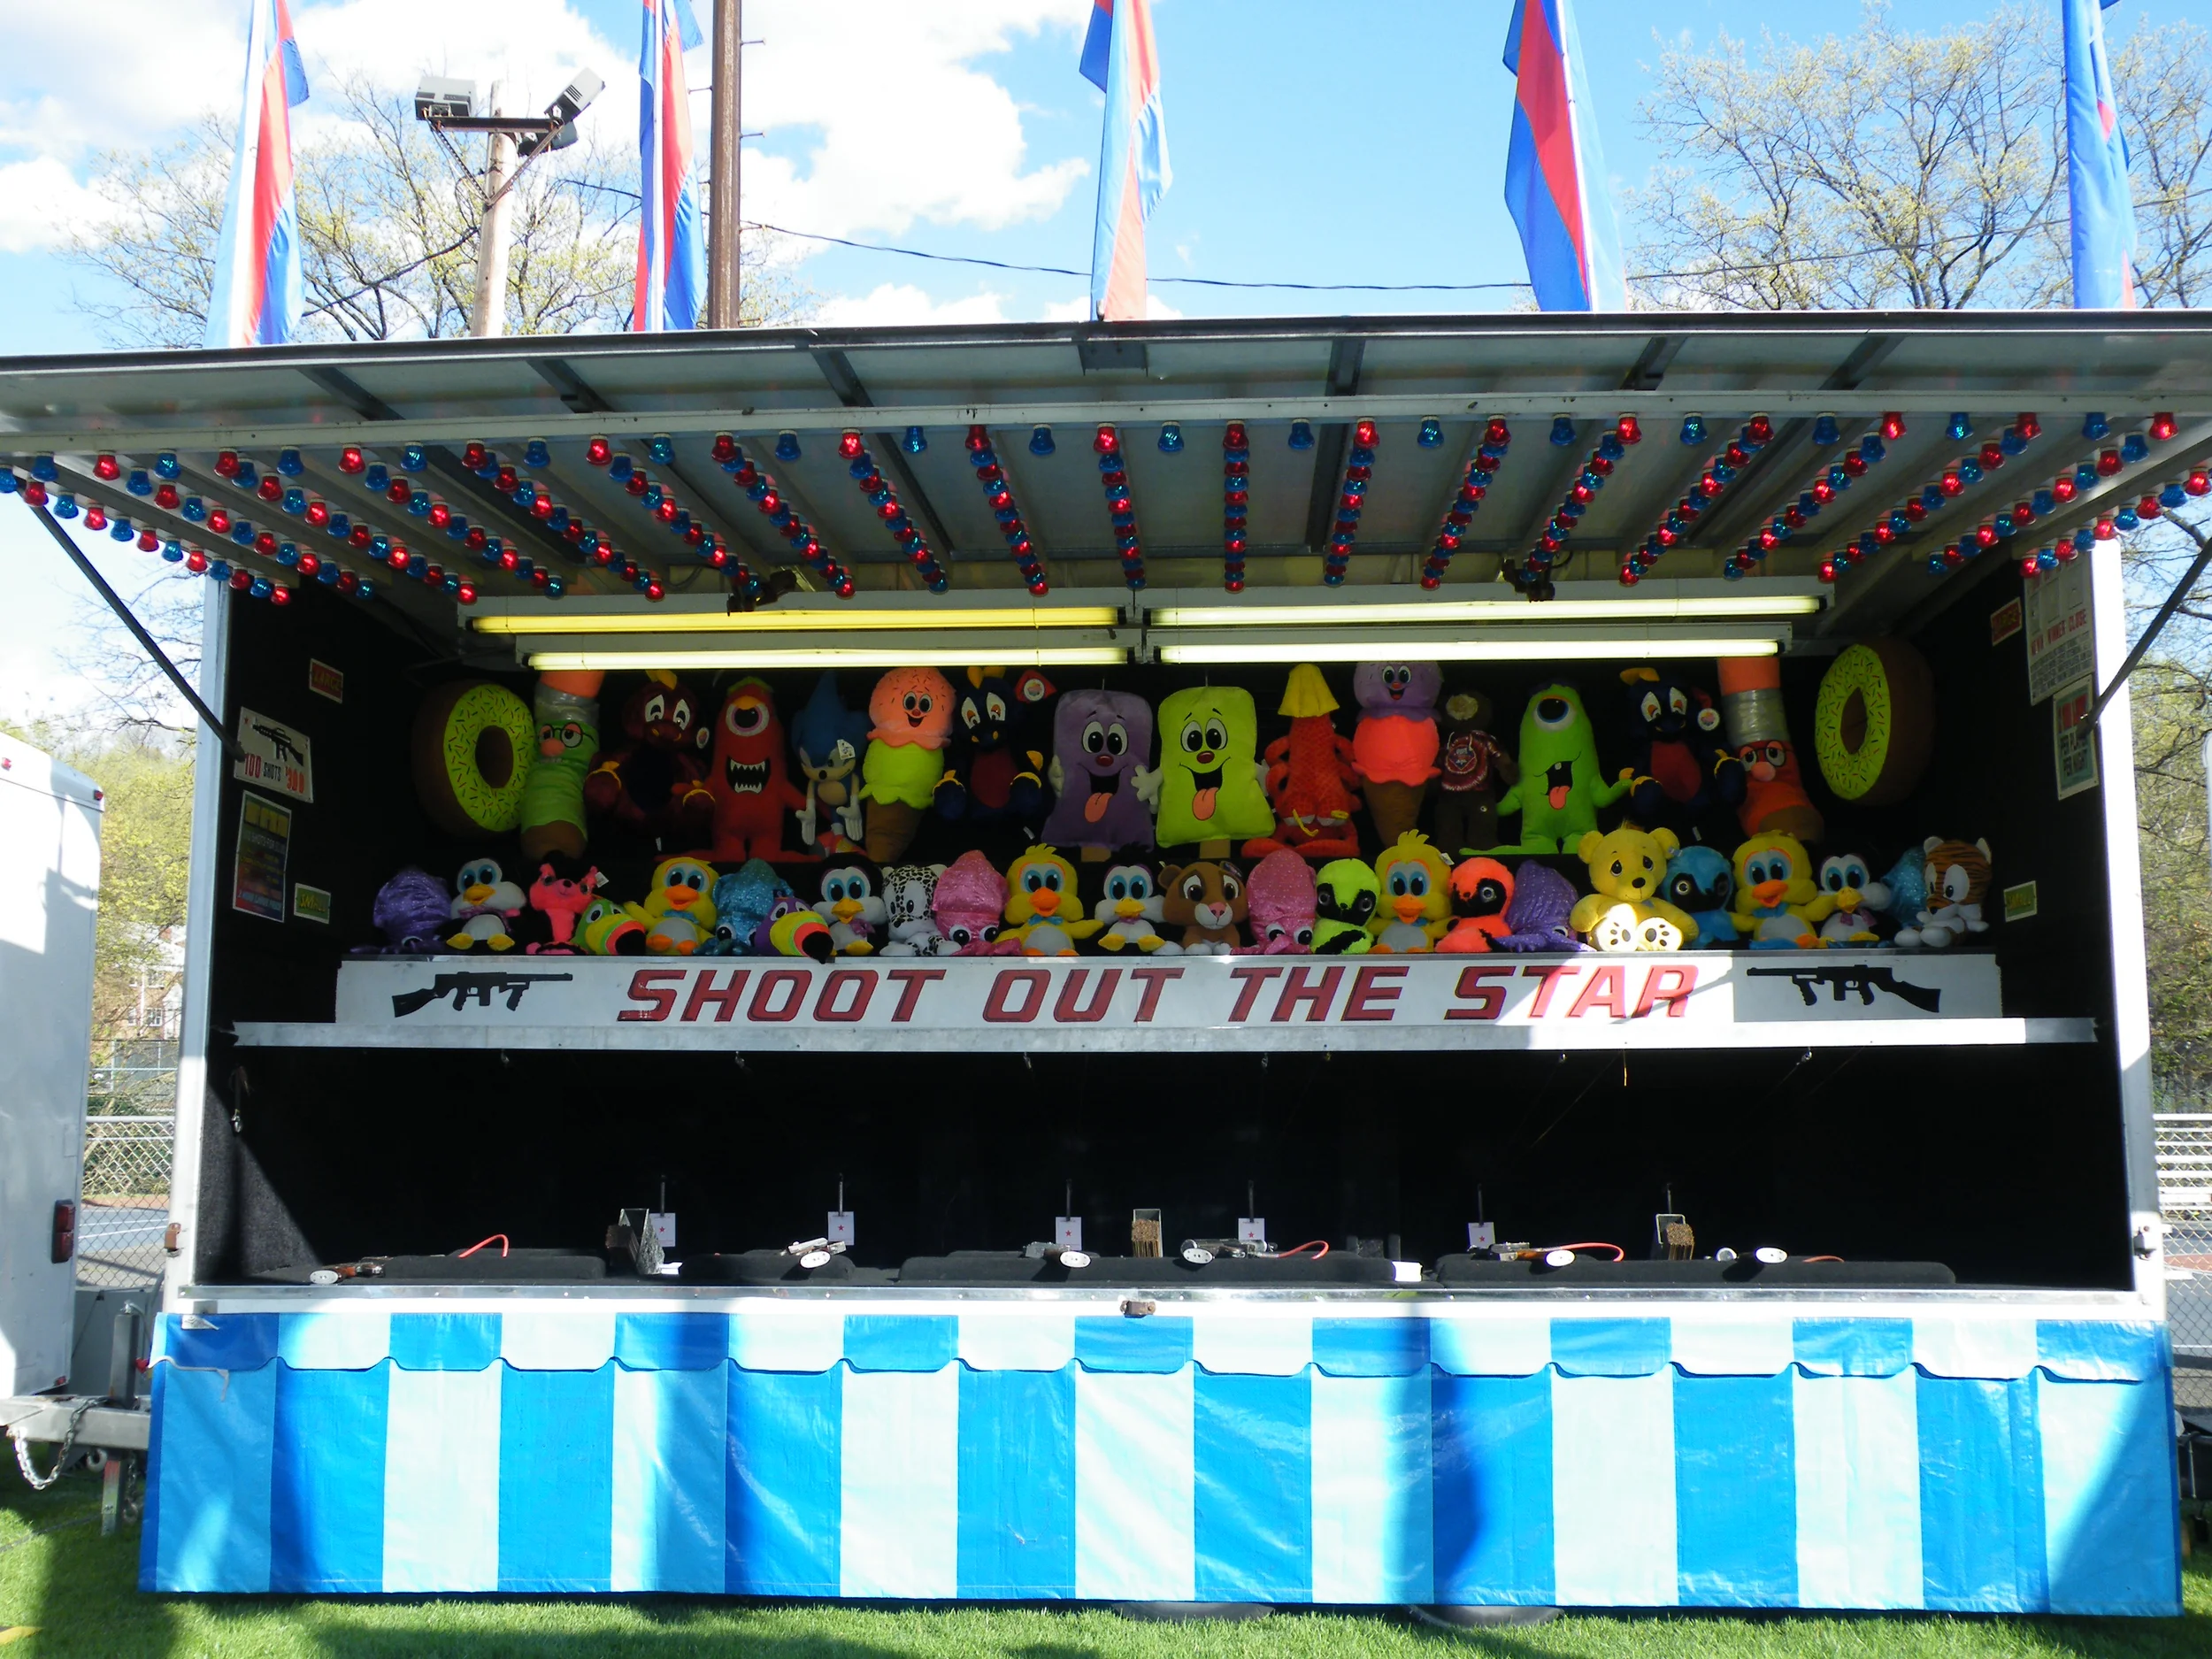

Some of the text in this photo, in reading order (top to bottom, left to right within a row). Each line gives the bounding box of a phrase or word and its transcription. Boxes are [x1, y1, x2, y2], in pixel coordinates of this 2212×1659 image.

[244, 753, 262, 778] 100
[263, 762, 281, 781] SHOTS
[617, 964, 1699, 1023] SHOOT OUT THE STAR
